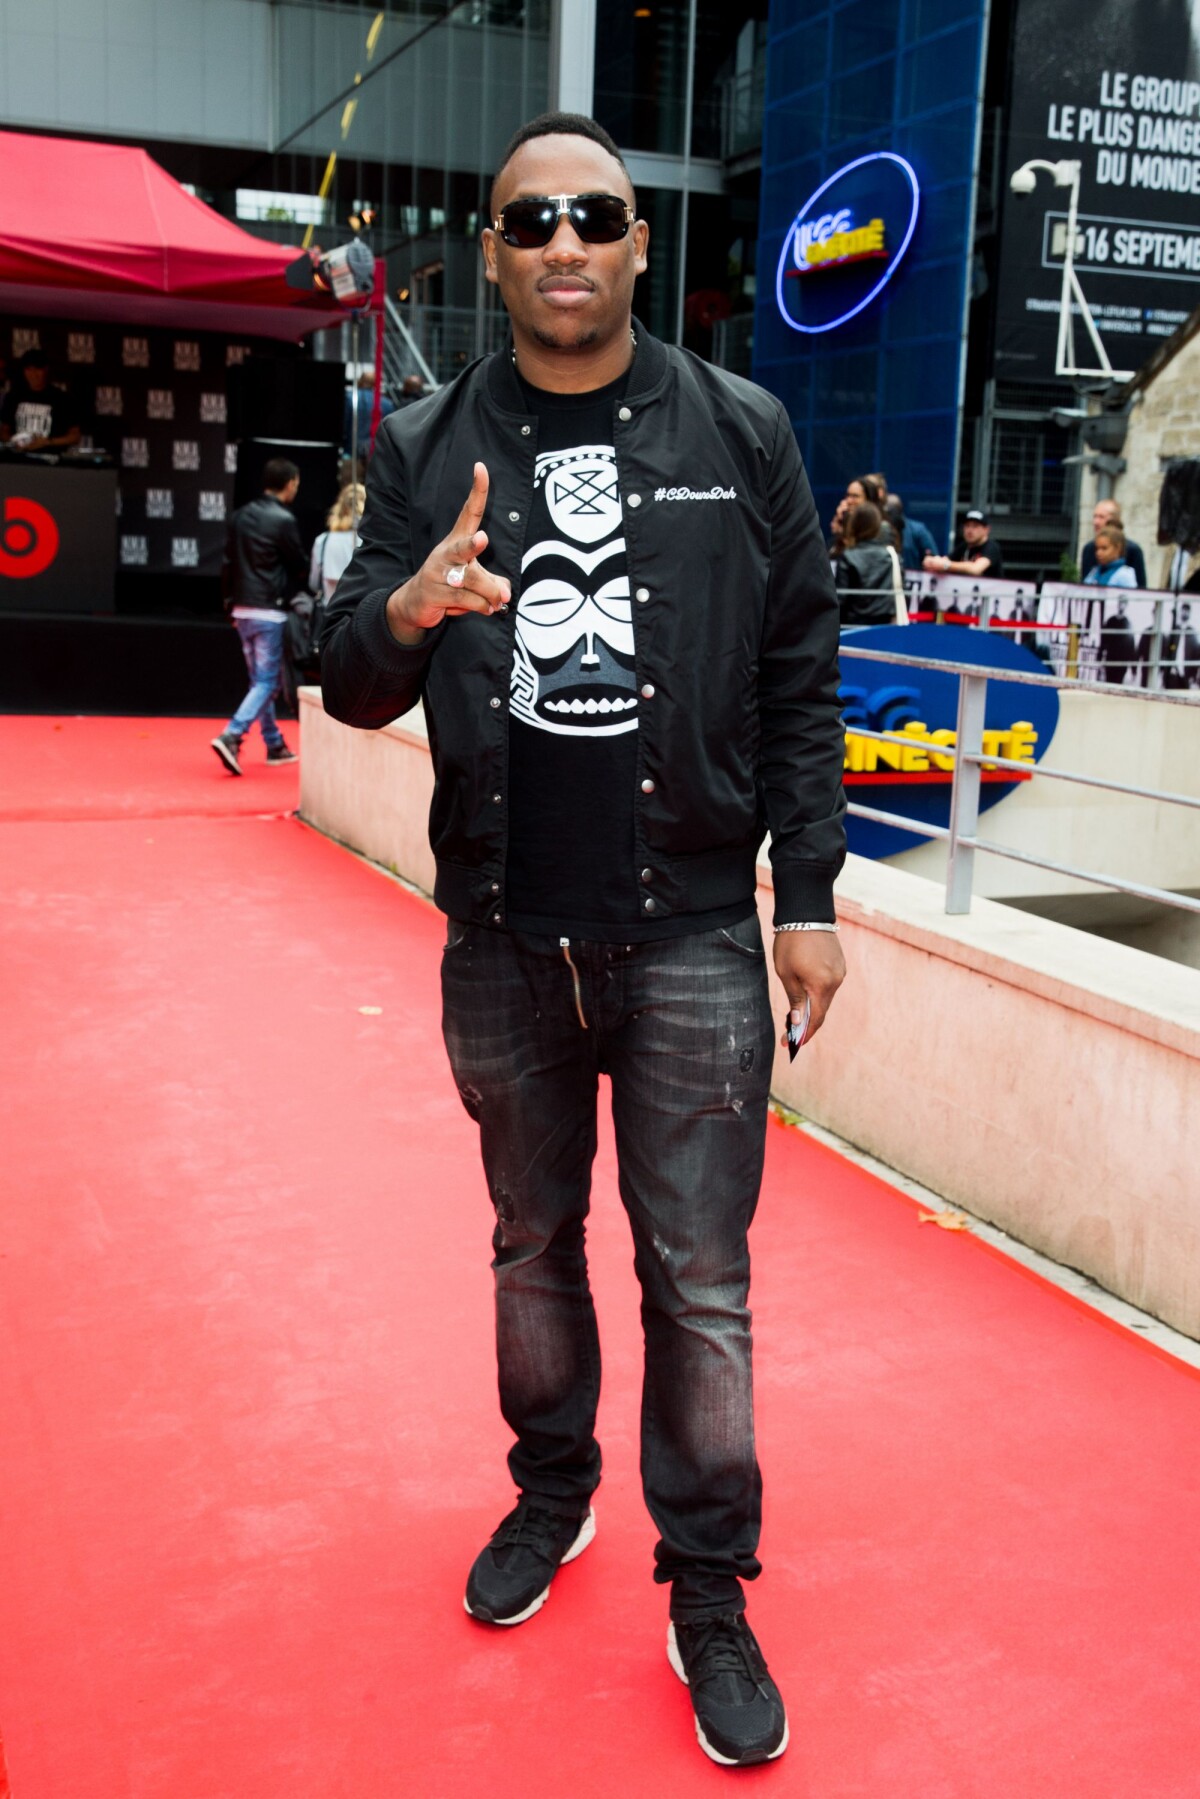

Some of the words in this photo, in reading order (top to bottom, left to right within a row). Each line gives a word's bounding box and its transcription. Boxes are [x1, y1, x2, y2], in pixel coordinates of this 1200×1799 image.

[1100, 70, 1129, 108] LE
[1130, 75, 1200, 118] GROUP
[1047, 103, 1076, 141] LE
[1078, 107, 1134, 148] PLUS
[1096, 149, 1127, 186] DU
[1085, 226, 1109, 262] 16
